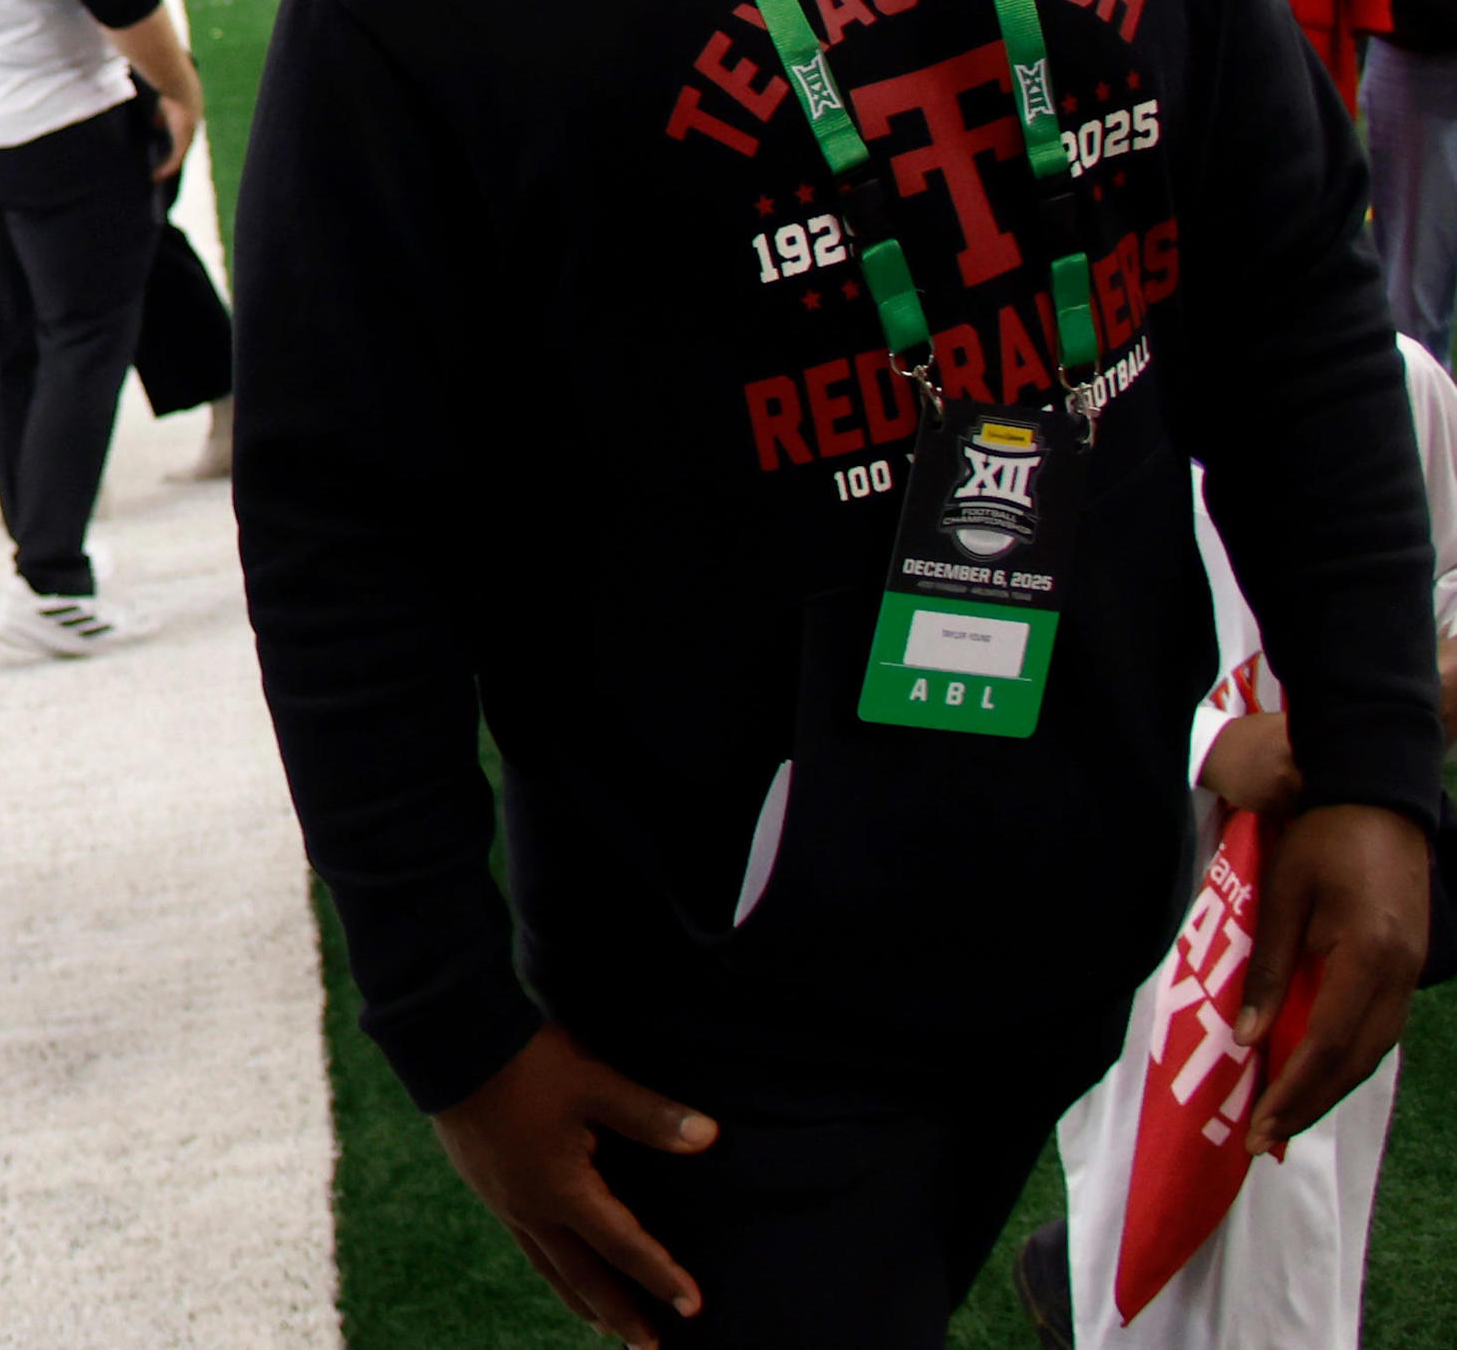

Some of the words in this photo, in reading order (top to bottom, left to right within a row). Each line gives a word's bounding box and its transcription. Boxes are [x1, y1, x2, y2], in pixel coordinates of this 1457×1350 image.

[751, 214, 856, 284] 192
[743, 345, 919, 472] RED
[930, 217, 1181, 407] RAIERS
[833, 459, 892, 502] 100
[954, 446, 1042, 509] XII
[902, 558, 991, 585] DECEMBER
[992, 570, 1008, 588] 6,
[1010, 572, 1053, 591] 2025
